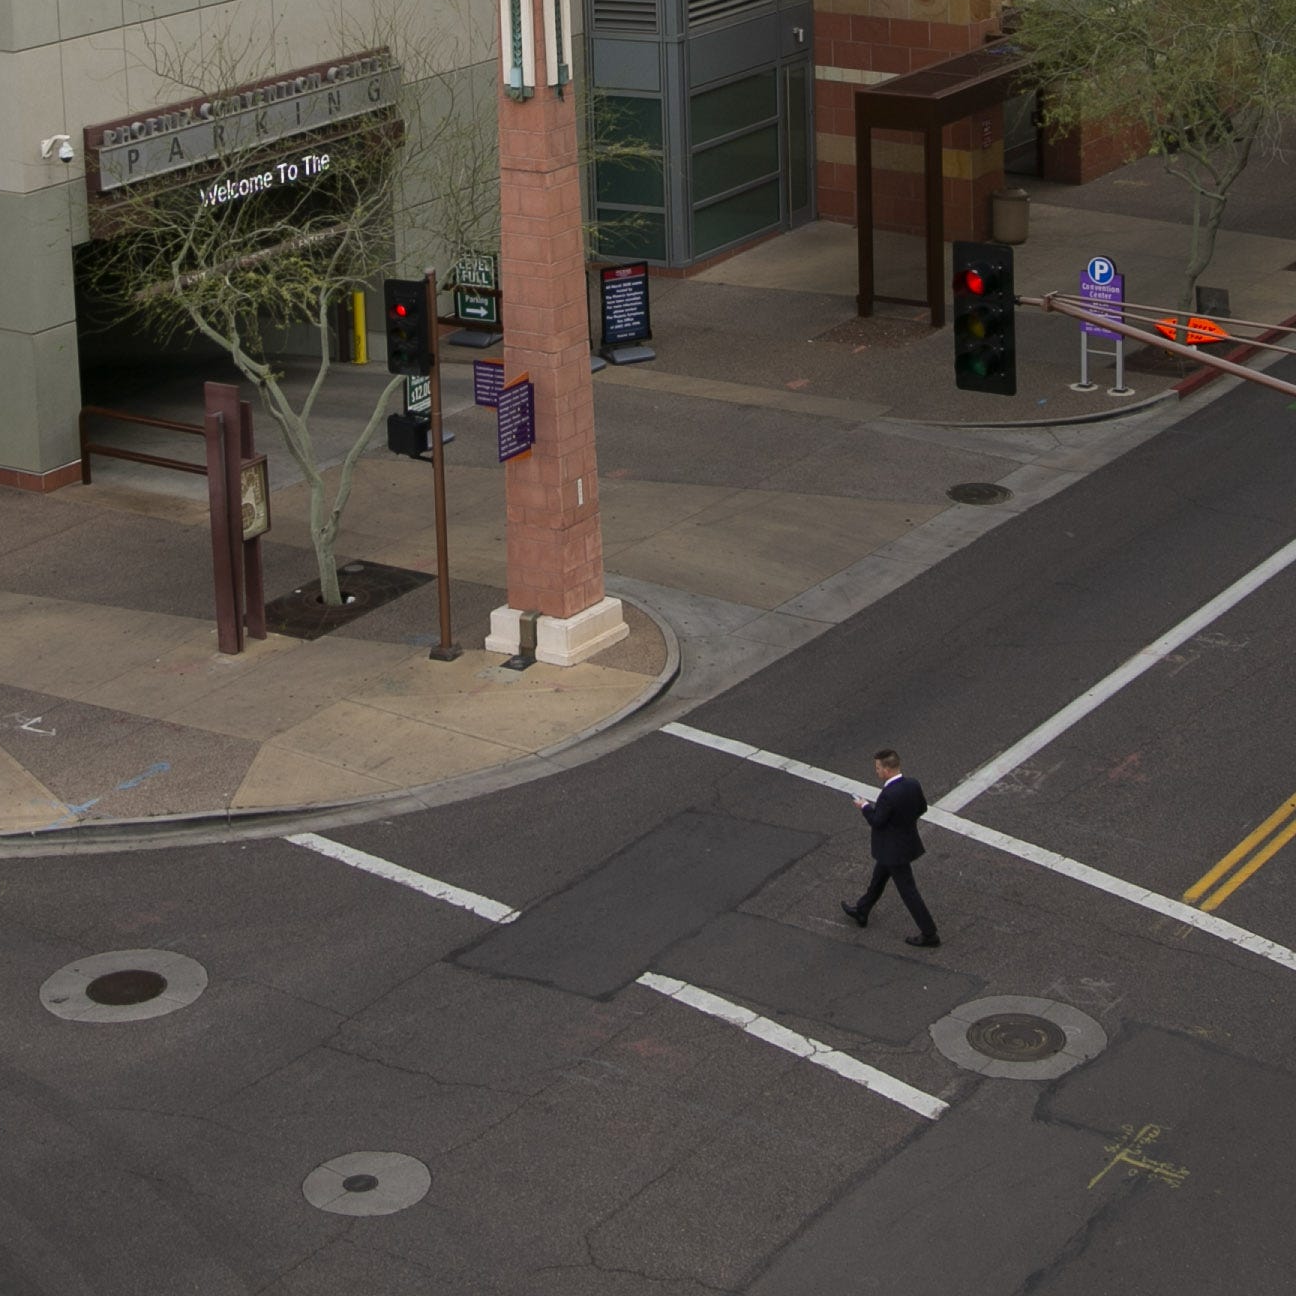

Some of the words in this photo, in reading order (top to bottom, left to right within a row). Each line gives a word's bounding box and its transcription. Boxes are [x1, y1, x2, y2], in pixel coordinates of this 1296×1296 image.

[200, 171, 273, 207] Welcome
[276, 162, 298, 184] To
[301, 153, 330, 176] The
[462, 270, 489, 284] FULL
[1082, 283, 1121, 294] Convention
[465, 294, 489, 306] Parking
[1089, 291, 1113, 300] Center
